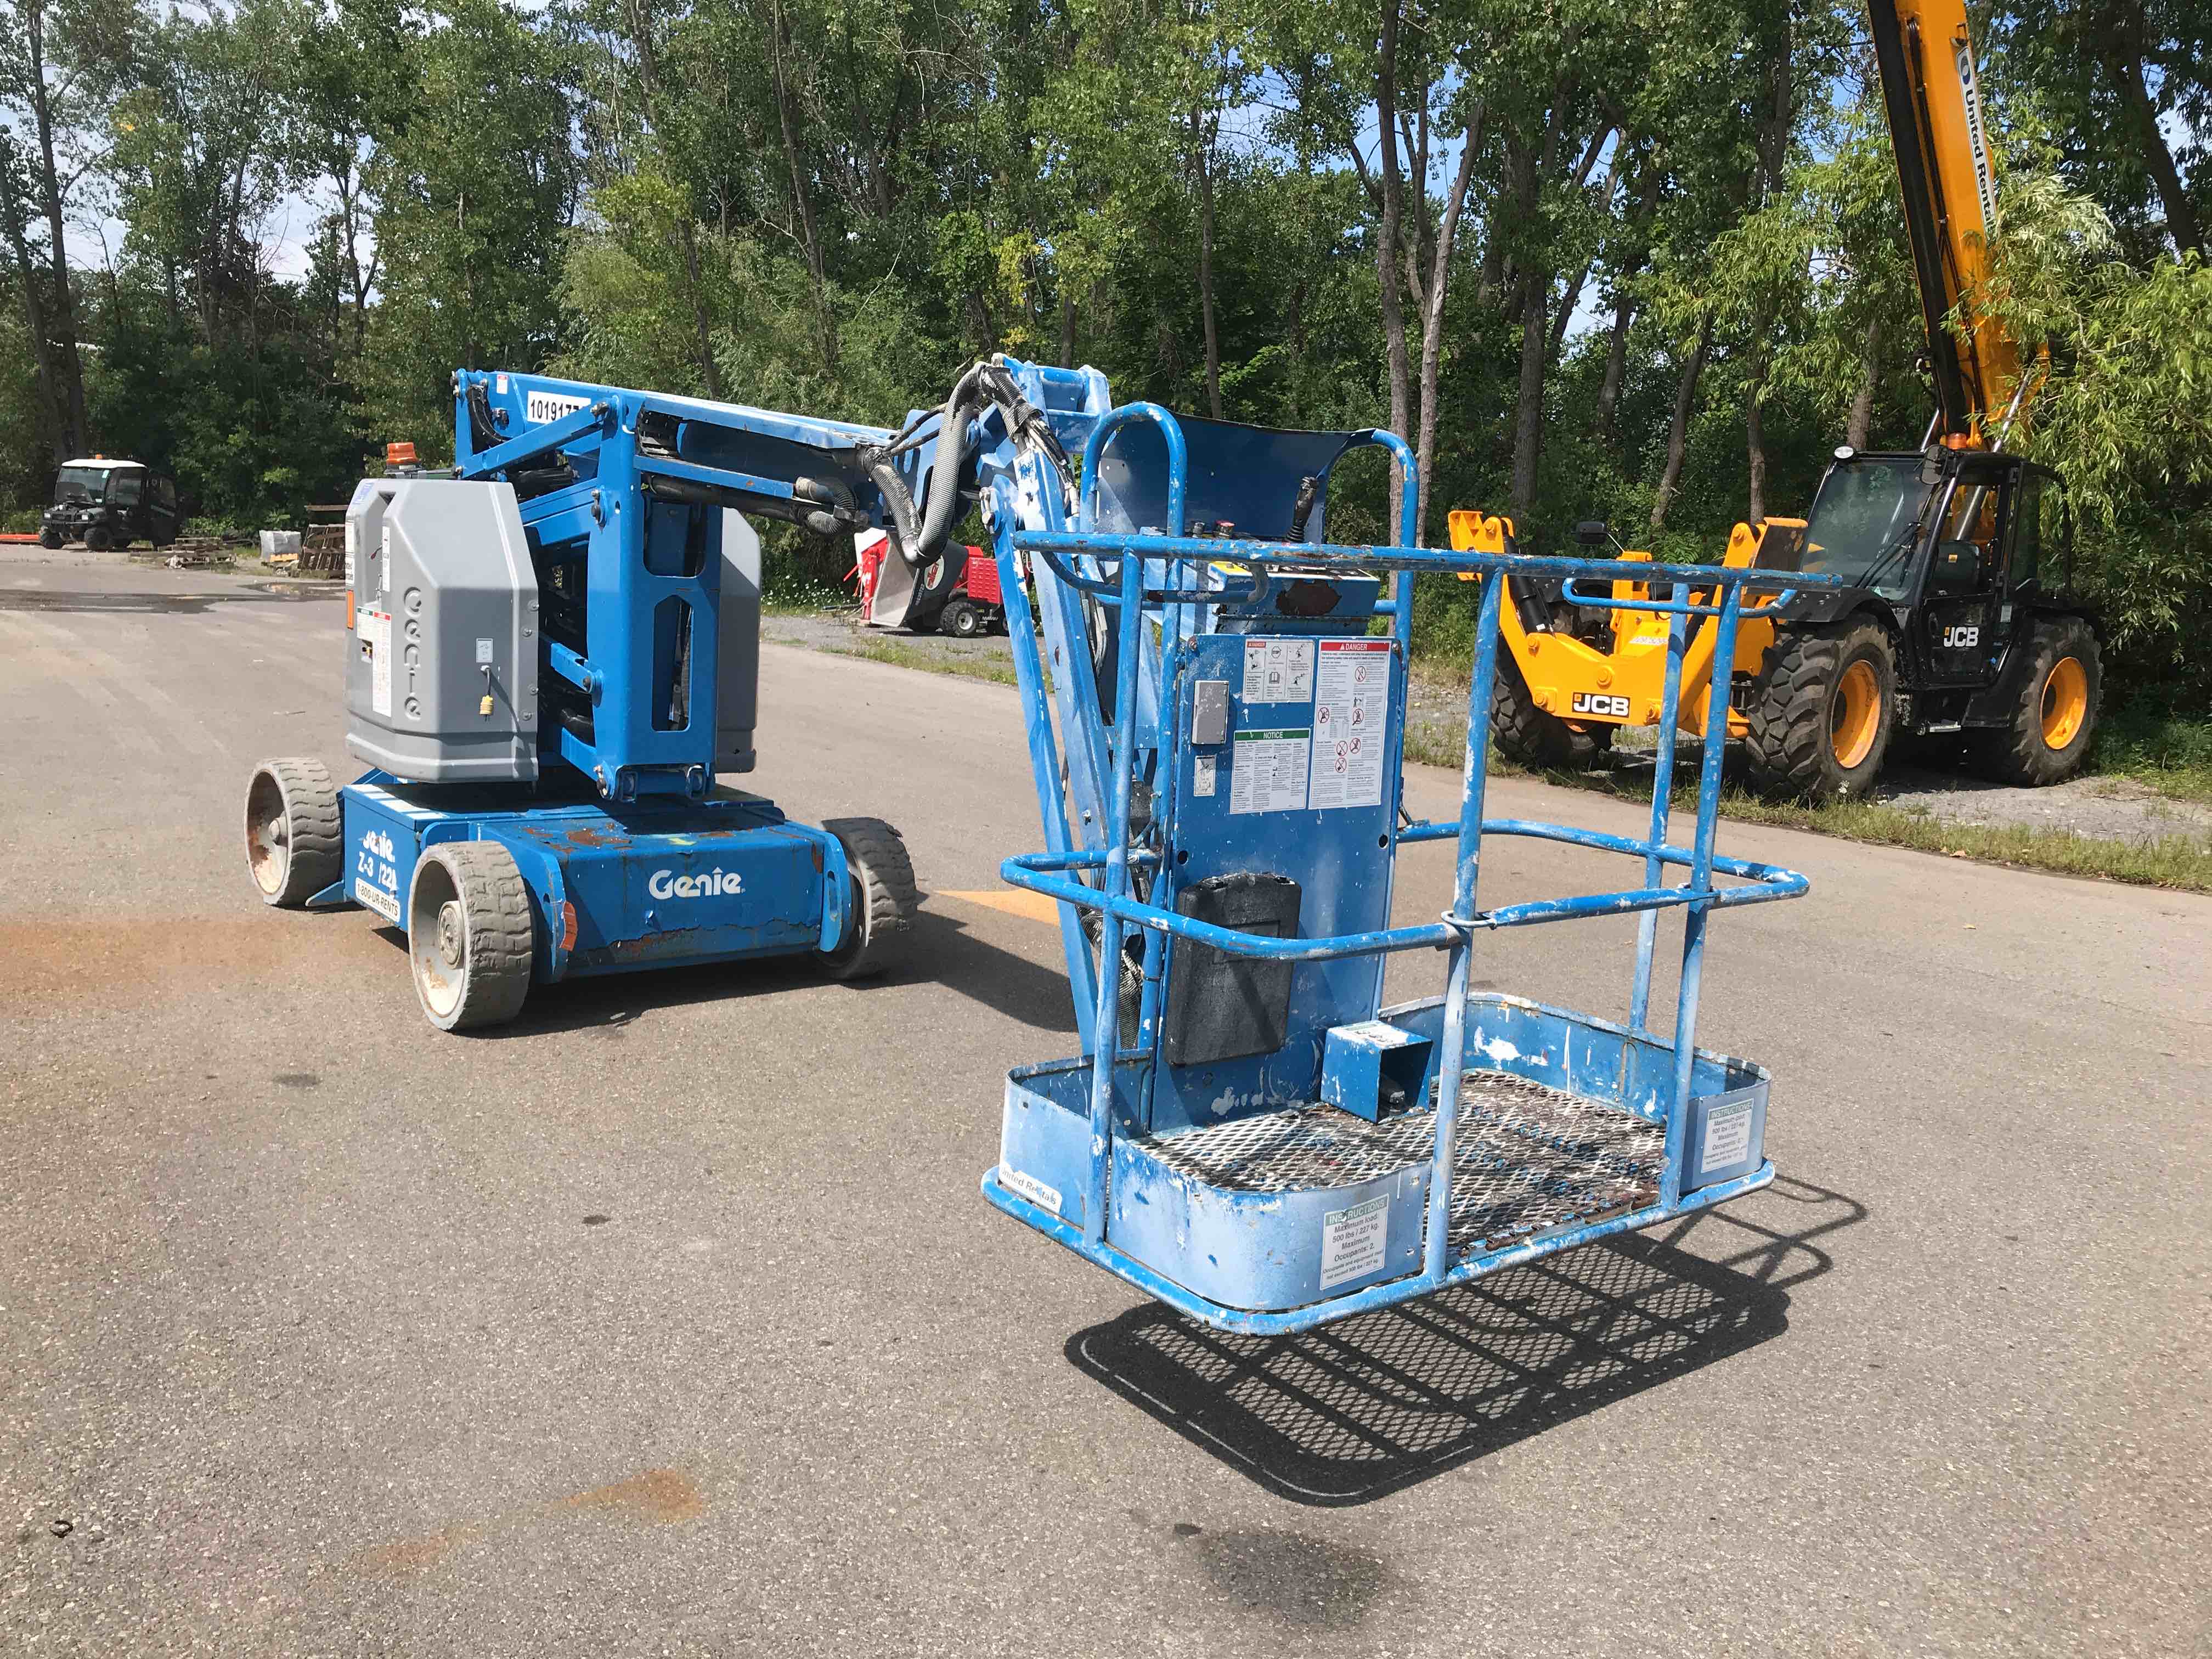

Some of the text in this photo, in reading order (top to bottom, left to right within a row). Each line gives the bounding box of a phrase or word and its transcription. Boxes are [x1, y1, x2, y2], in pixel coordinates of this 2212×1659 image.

[1966, 89, 1983, 158] United
[1944, 627, 1978, 647] JCB
[1573, 693, 1629, 716] JCB
[648, 866, 742, 900] Genie
[1329, 1200, 1385, 1224] INSRUCTIONS
[1333, 1234, 1344, 1243] 500
[1345, 1231, 1355, 1239] lbs
[1359, 1226, 1370, 1234] 227
[1334, 1219, 1364, 1233] Maximum
[1341, 1235, 1370, 1250] Maximum
[1334, 1246, 1368, 1262] Occupants:
